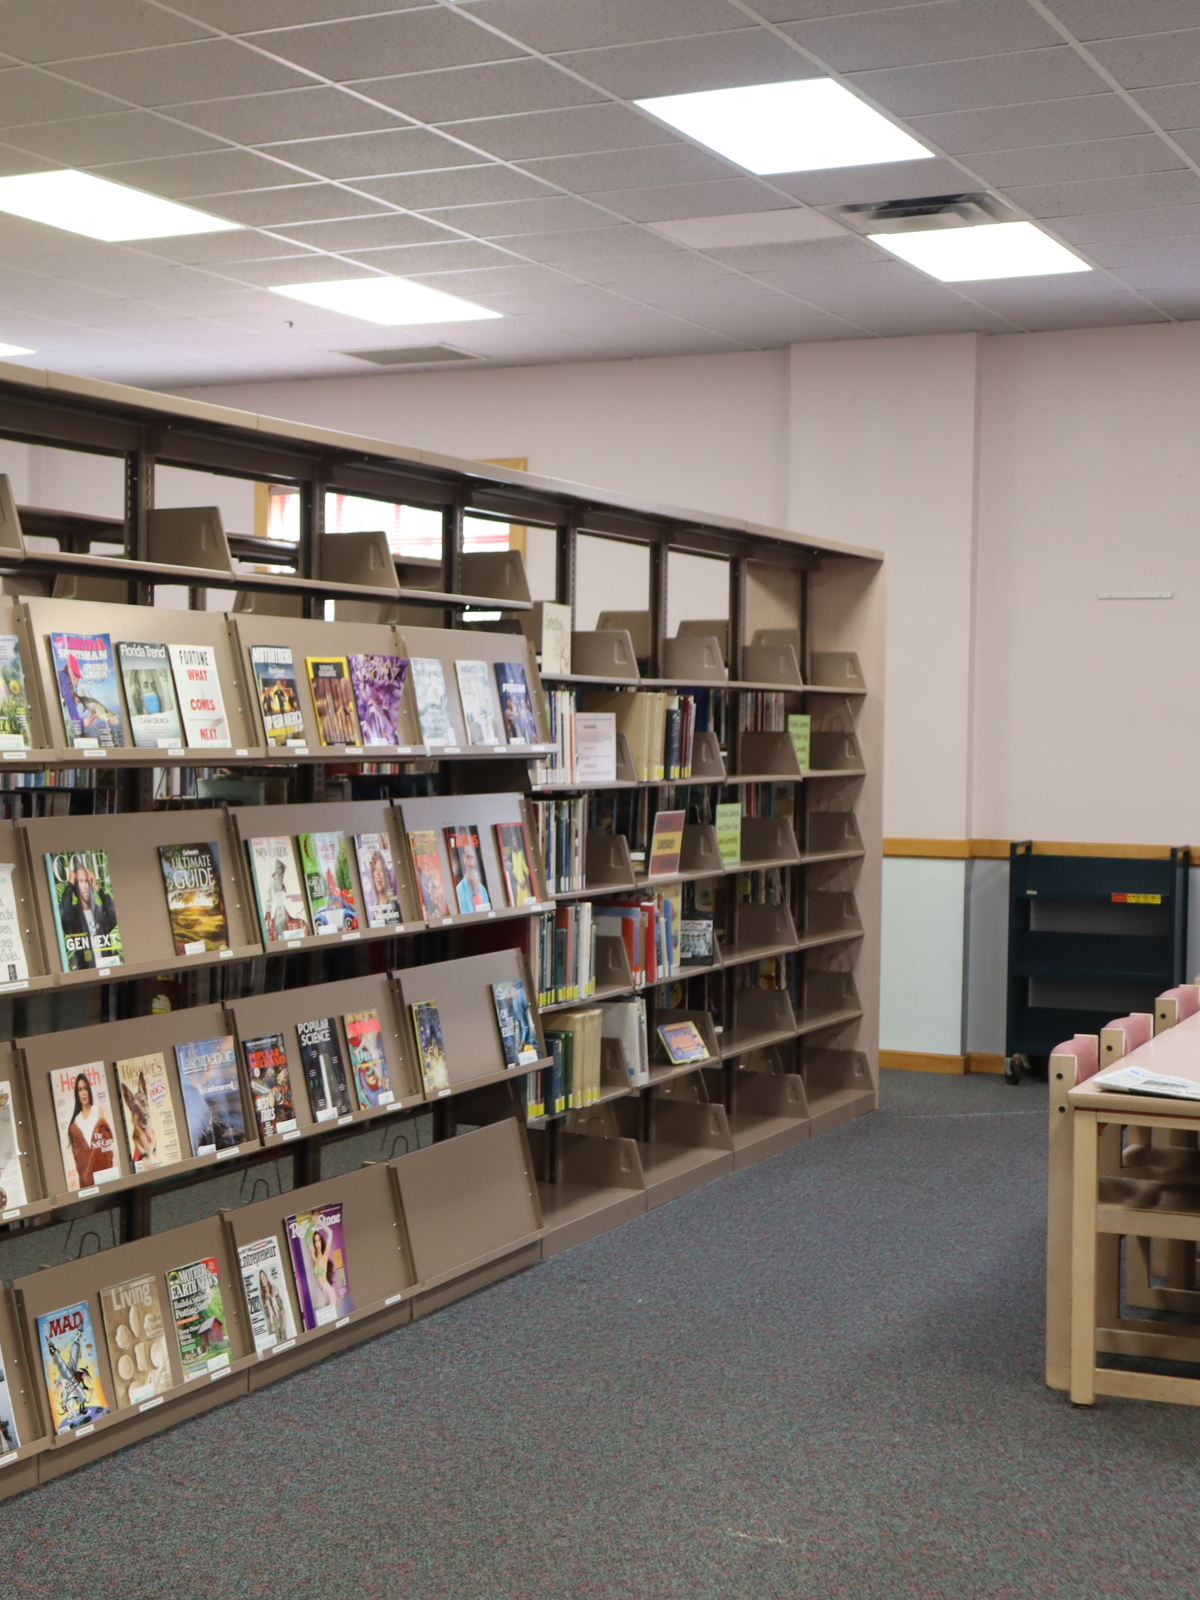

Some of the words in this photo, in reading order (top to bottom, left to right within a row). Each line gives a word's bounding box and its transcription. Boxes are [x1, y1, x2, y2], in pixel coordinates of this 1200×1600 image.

[120, 644, 144, 658] Florida
[145, 645, 166, 658] Trend
[179, 650, 209, 666] FORTUNE
[186, 669, 208, 682] WHAT
[190, 699, 216, 711] COMES
[200, 728, 217, 740] NEXT
[172, 855, 211, 870] ULTIMATE
[174, 867, 214, 889] GUIDE
[66, 935, 89, 950] GEN
[91, 934, 118, 948] NEXT
[298, 1018, 330, 1034] POPULAR
[301, 1030, 330, 1046] SCIENCE
[122, 1058, 162, 1080] Reader's
[60, 1067, 102, 1092] Helth
[149, 1083, 166, 1098] DOGS
[178, 1263, 206, 1284] MOTHER
[170, 1280, 197, 1300] EARTH
[197, 1273, 218, 1291] NEWS
[110, 1283, 150, 1310] Living
[49, 1311, 84, 1338] MAD
